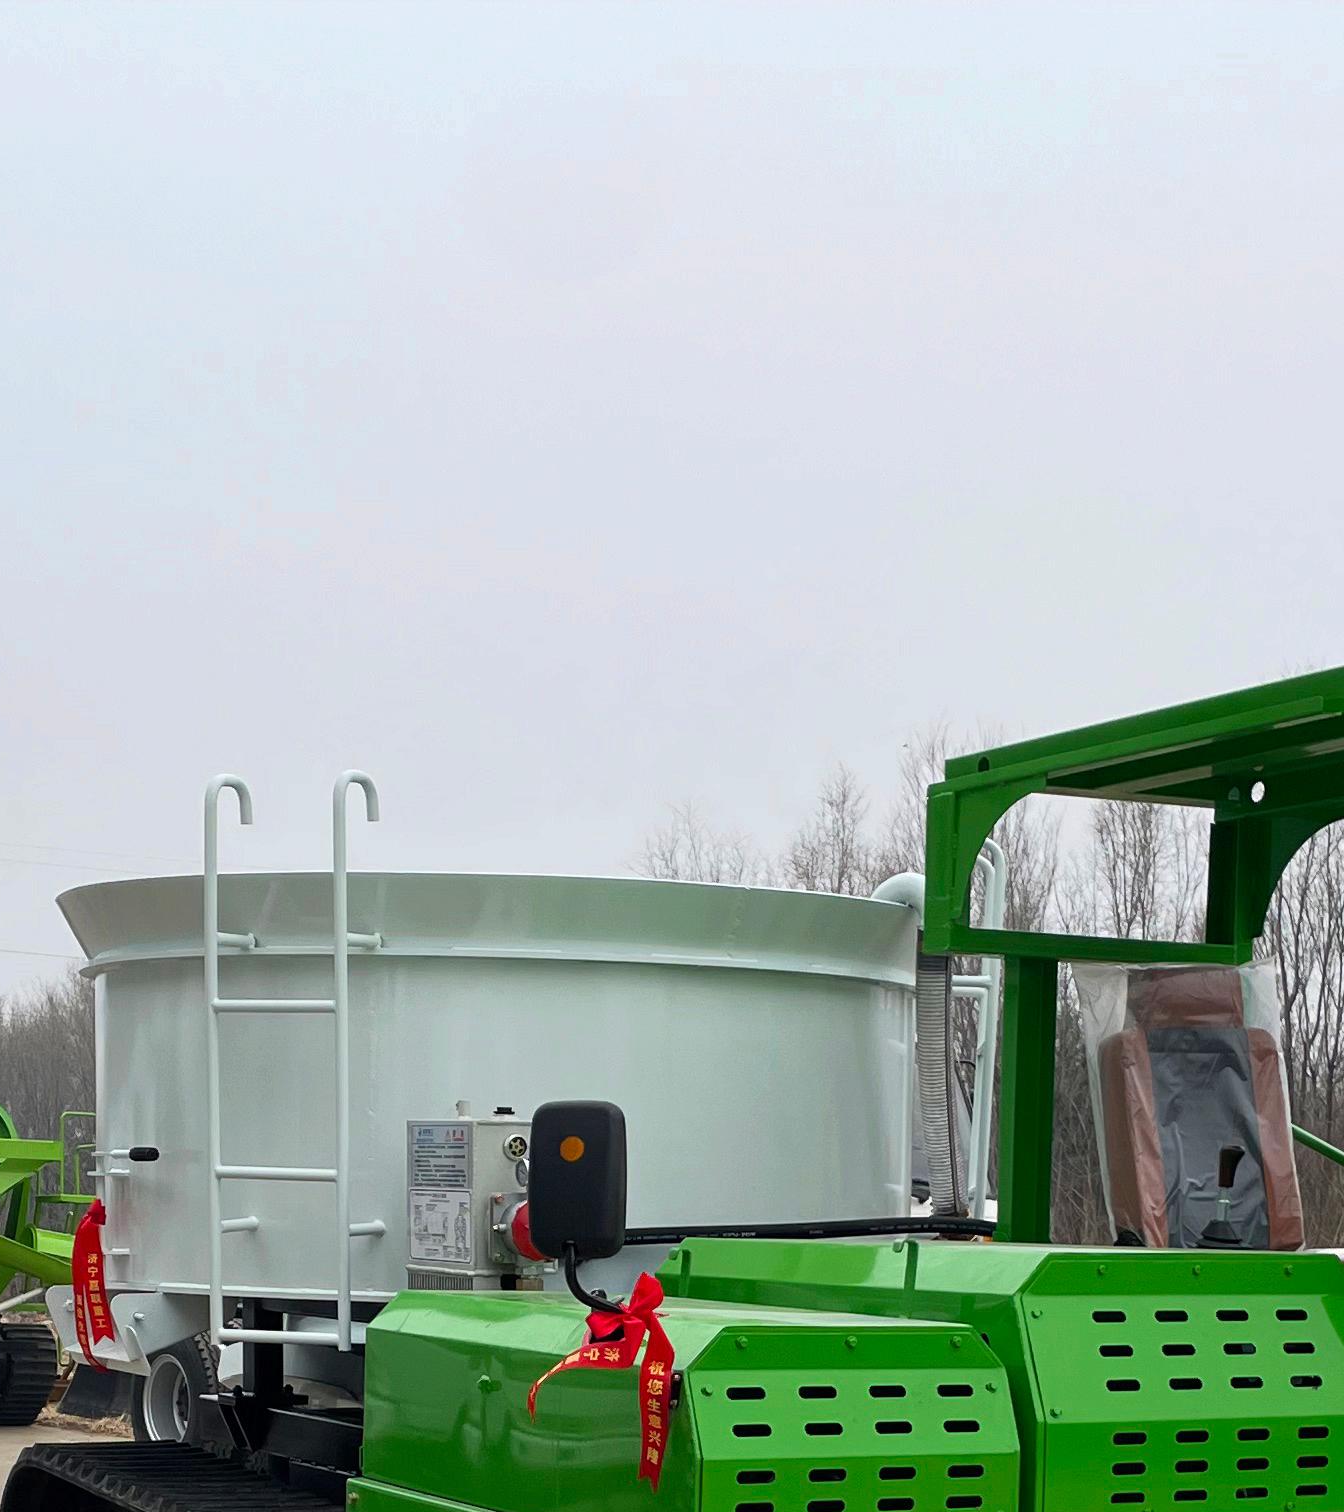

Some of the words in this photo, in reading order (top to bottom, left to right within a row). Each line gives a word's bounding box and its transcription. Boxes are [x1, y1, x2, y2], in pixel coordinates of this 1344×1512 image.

[646, 1360, 665, 1465] 祝您生意兴隆
